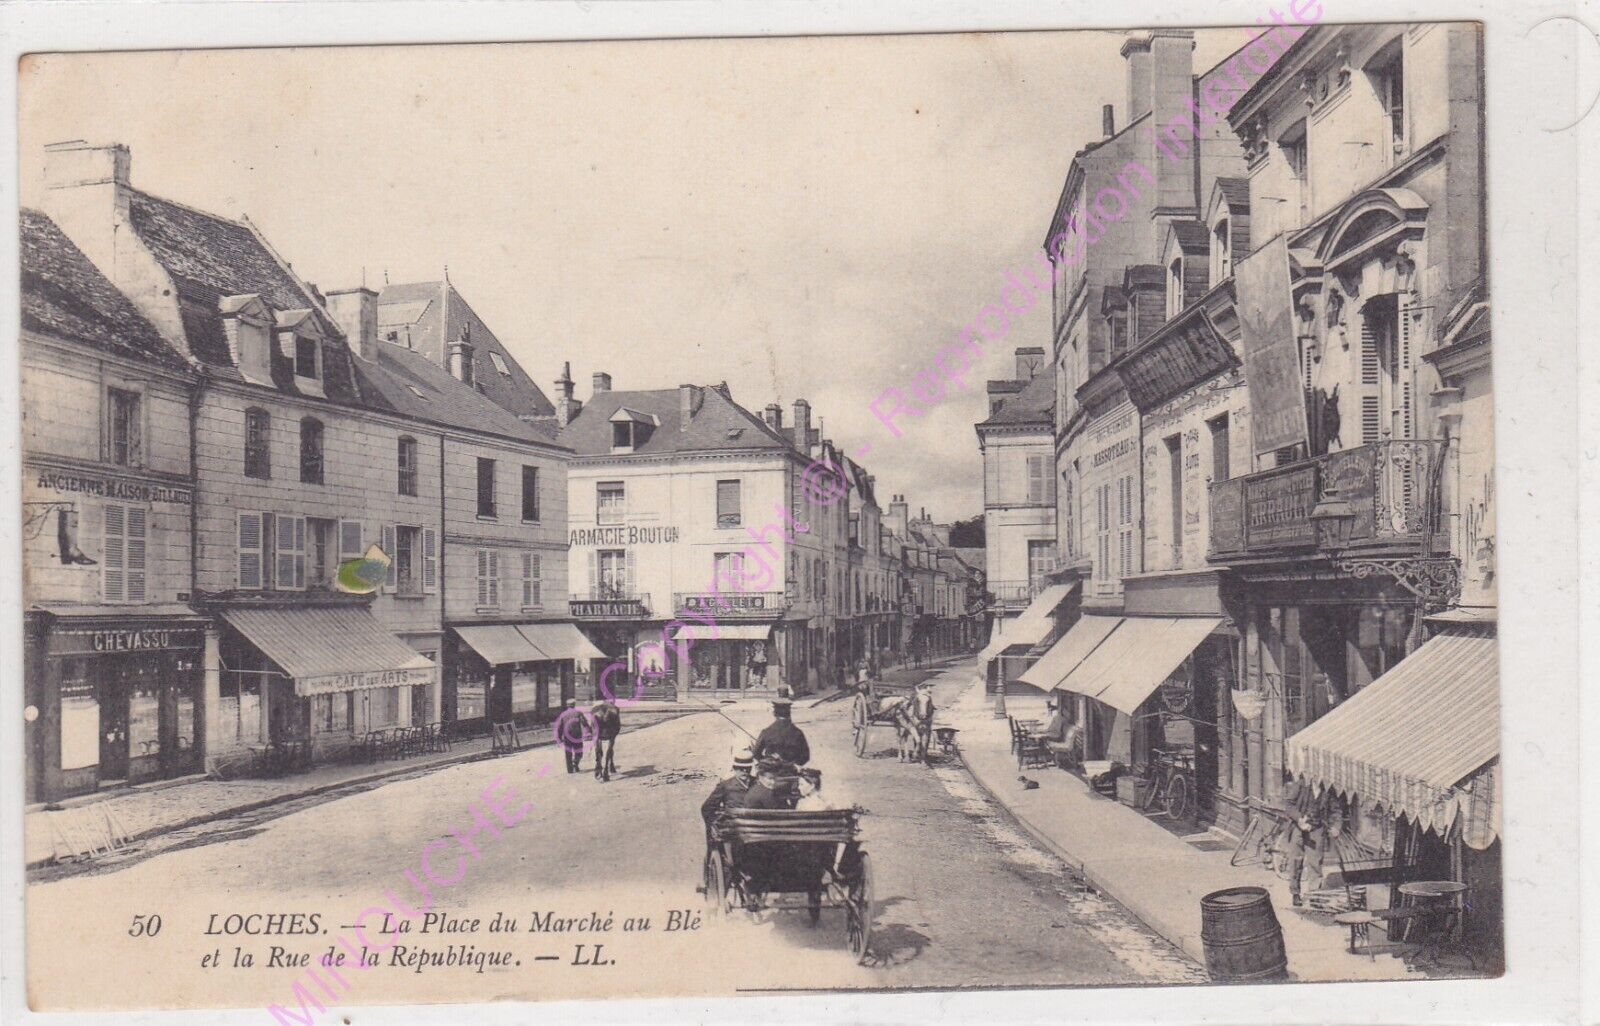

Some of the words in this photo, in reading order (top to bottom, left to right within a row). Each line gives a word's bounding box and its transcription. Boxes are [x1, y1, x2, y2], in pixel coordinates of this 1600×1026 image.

[628, 525, 680, 545] BOUTON
[569, 603, 640, 616] PHARMACIE
[94, 631, 169, 652] CHEVASSU
[381, 670, 408, 684] ARTS
